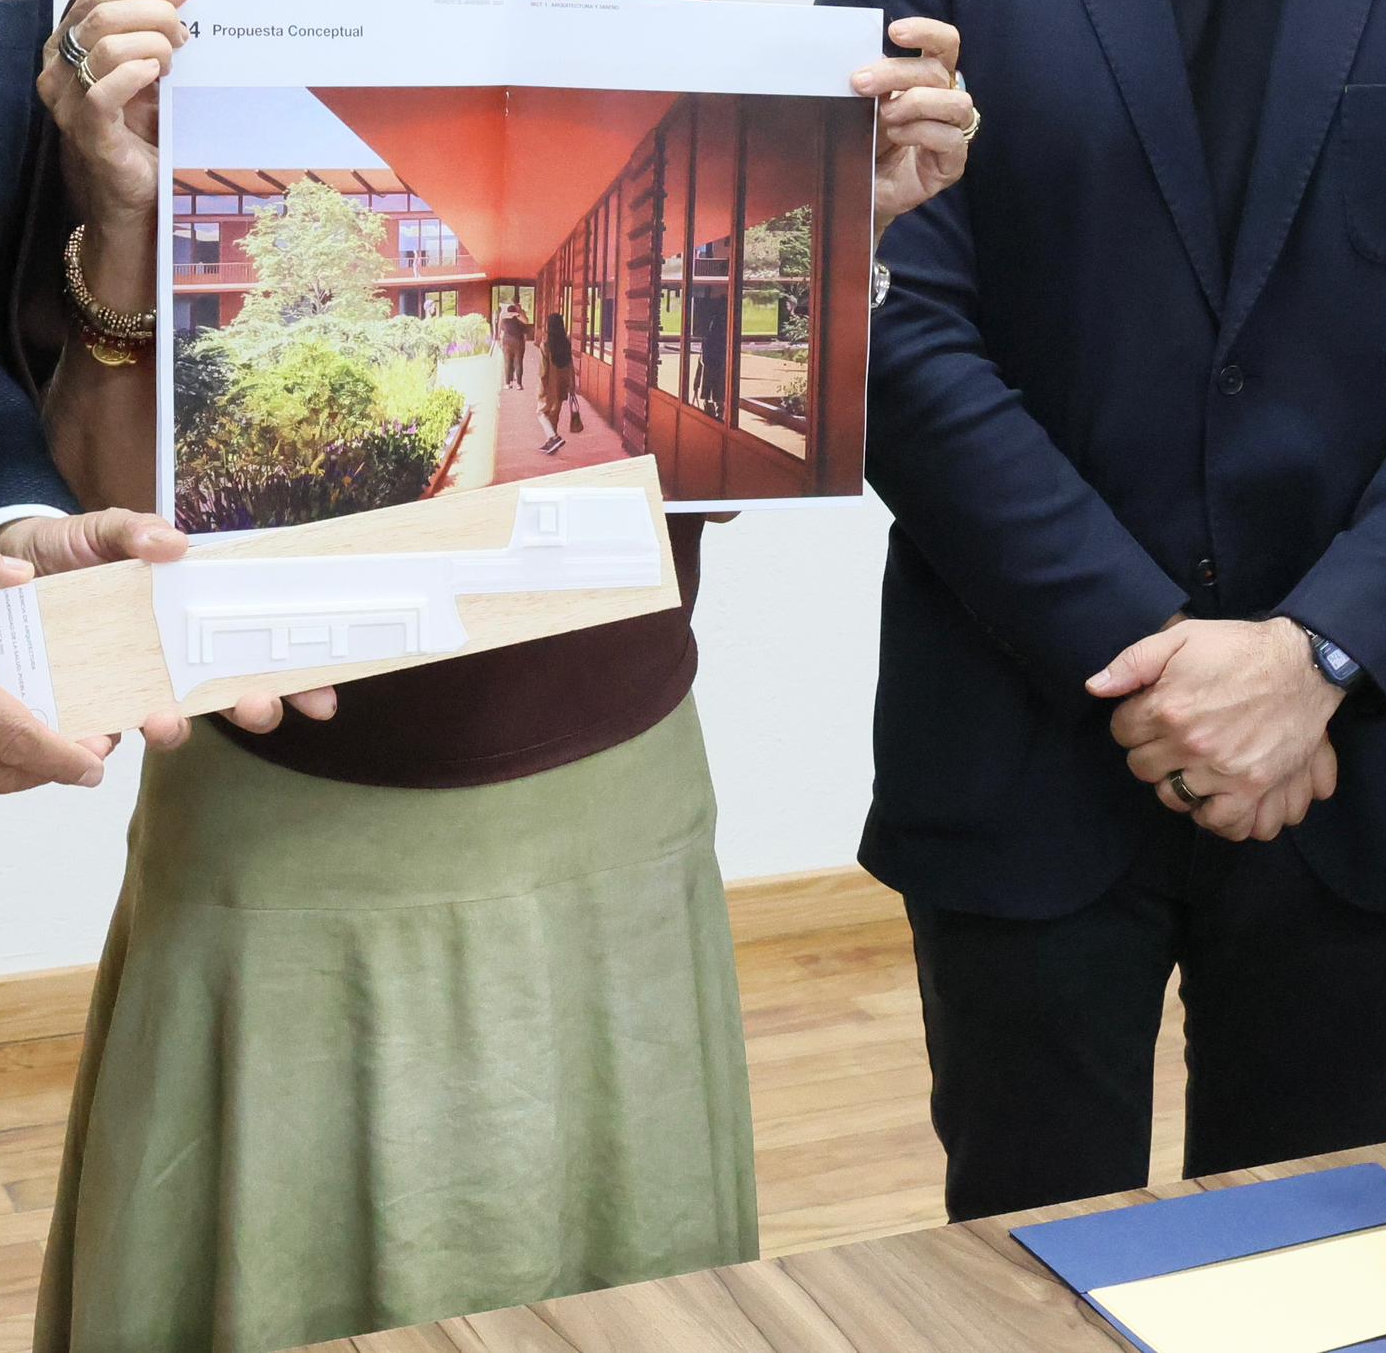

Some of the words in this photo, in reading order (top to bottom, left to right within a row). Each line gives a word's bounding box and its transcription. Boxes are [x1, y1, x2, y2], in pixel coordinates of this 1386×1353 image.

[180, 20, 201, 39] 4
[212, 23, 284, 39] Propuesta
[287, 24, 364, 40] Conceptual
